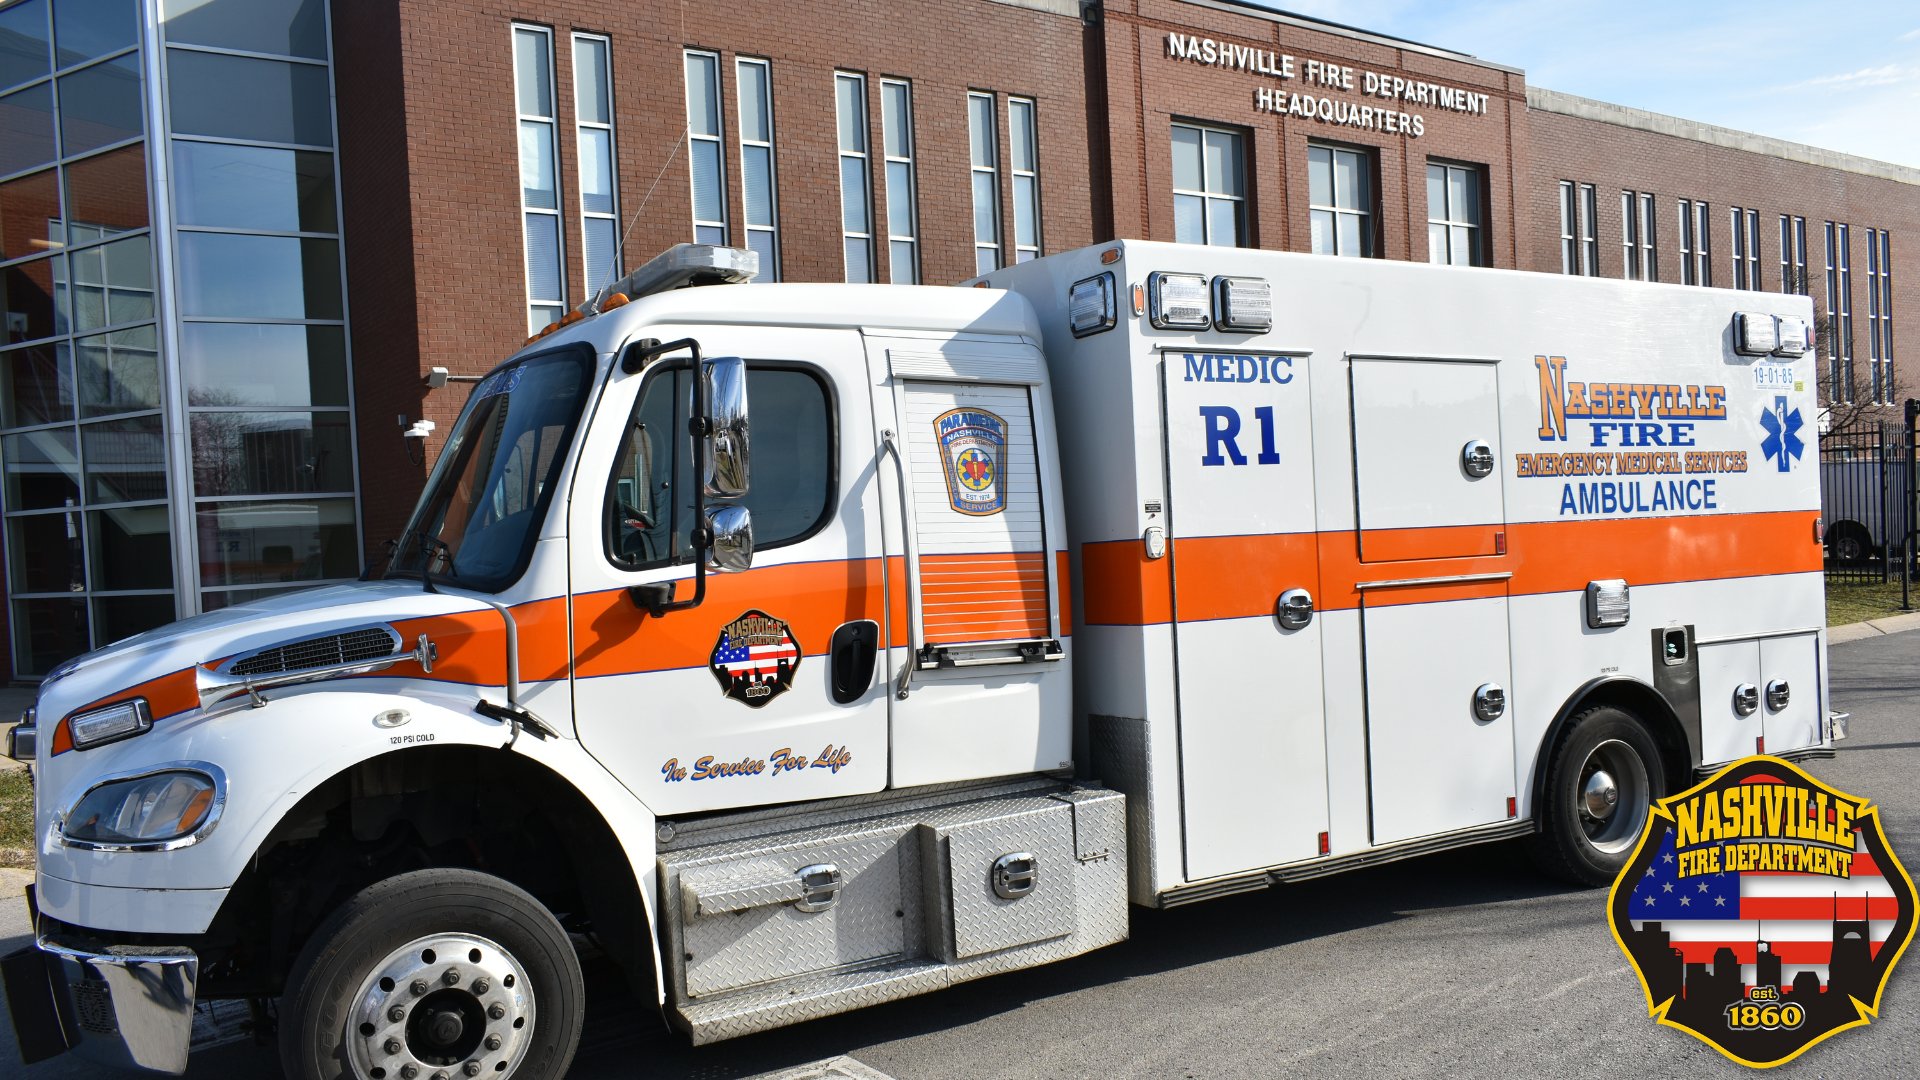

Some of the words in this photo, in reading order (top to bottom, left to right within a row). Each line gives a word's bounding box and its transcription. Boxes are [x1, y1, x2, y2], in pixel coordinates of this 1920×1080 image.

[1168, 32, 1295, 78] NASHVILLE
[1308, 60, 1354, 89] FIRE
[1366, 71, 1489, 114] DEPARTMENT
[1258, 87, 1424, 136] HEADQUARTERS
[1183, 354, 1294, 384] MEDIC
[1754, 367, 1793, 384] 19-01-85
[1535, 355, 1727, 441] NASHVILLE
[946, 429, 998, 443] NASHVILLE
[1199, 406, 1280, 466] R1
[1590, 423, 1695, 447] FIRE
[1516, 452, 1613, 477] EMERGENCY
[1616, 452, 1682, 475] MEDICAL
[1684, 451, 1748, 473] SERVICES
[960, 502, 997, 510] SERVICE
[1560, 479, 1716, 515] AMBULANCE
[728, 617, 783, 640] NASHVILLE
[744, 636, 782, 646] DEPARTMENT
[747, 687, 769, 696] 1860
[390, 736, 401, 744] 120
[404, 735, 414, 743] PSI
[417, 733, 435, 742] COLD
[661, 757, 687, 783] In
[690, 756, 765, 781] Service
[770, 748, 808, 776] For
[810, 744, 851, 774] Life
